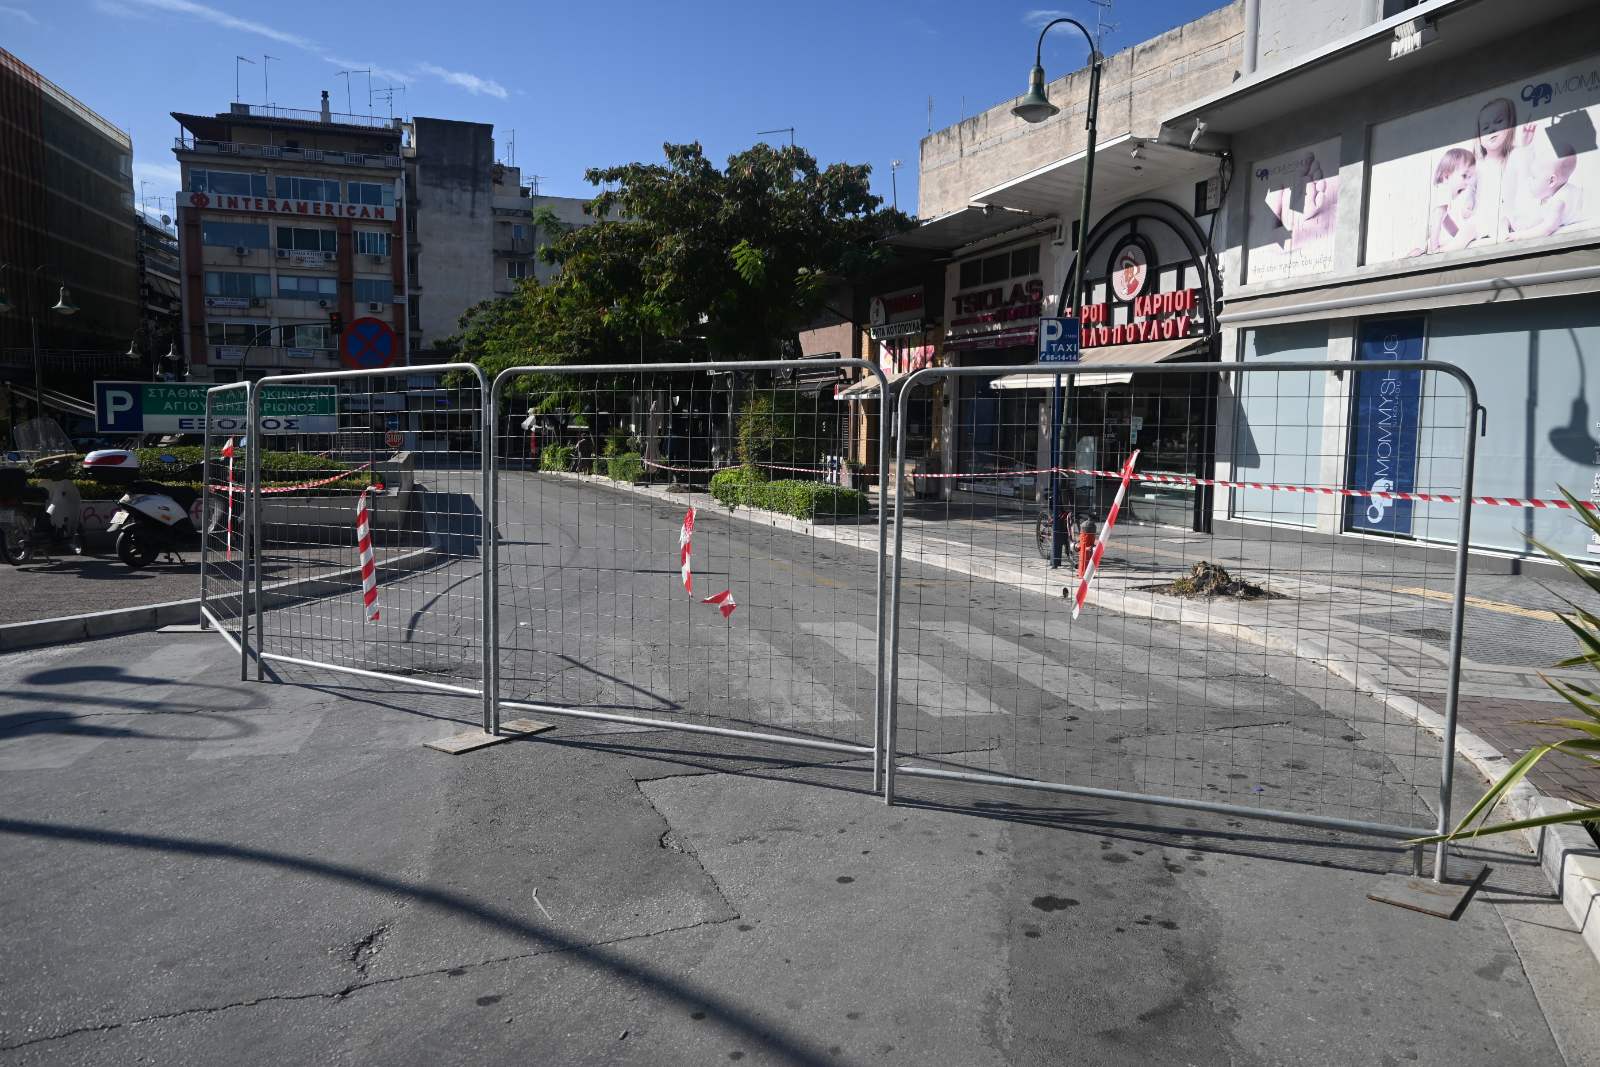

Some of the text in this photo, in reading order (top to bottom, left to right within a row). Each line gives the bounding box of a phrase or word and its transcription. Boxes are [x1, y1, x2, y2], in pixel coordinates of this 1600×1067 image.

[216, 195, 385, 218] INTERAMERICAN
[1064, 303, 1104, 324] ΡΟΙ
[1134, 288, 1191, 317] ΚΑΡΠΟΙ
[1041, 320, 1063, 352] P
[1050, 343, 1077, 352] TAXI
[225, 390, 329, 401] ΑΥΟΚΙΝΗΤΩΝ
[106, 389, 134, 425] P
[216, 402, 316, 412] ΒΗΣΡΙΩΝΟΣ
[386, 433, 402, 443] STOP
